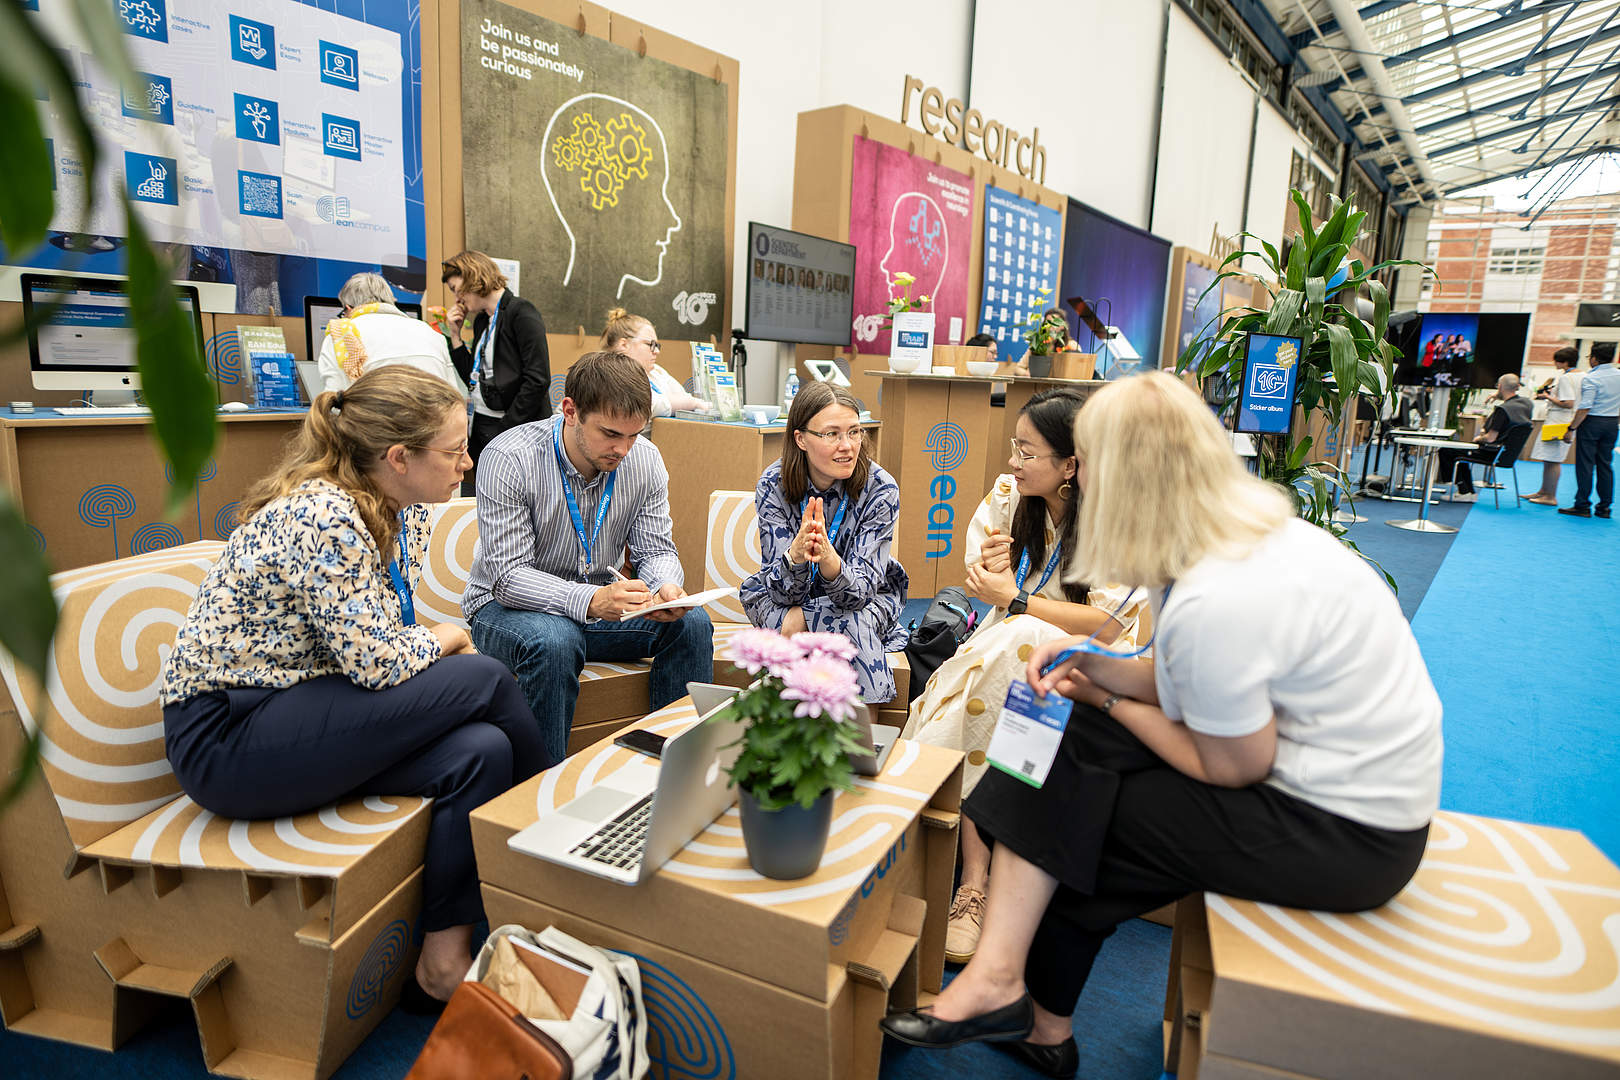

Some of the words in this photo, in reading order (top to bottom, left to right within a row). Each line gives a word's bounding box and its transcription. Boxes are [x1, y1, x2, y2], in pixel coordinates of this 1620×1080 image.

[480, 18, 512, 41] Join
[515, 32, 531, 47] us
[533, 38, 559, 56] and
[480, 34, 499, 54] be
[502, 44, 584, 83] passionately
[480, 56, 532, 80] curious
[176, 101, 215, 114] Guidelines
[902, 74, 1047, 185] research
[1249, 403, 1268, 412] Sticker
[926, 474, 957, 559] ean
